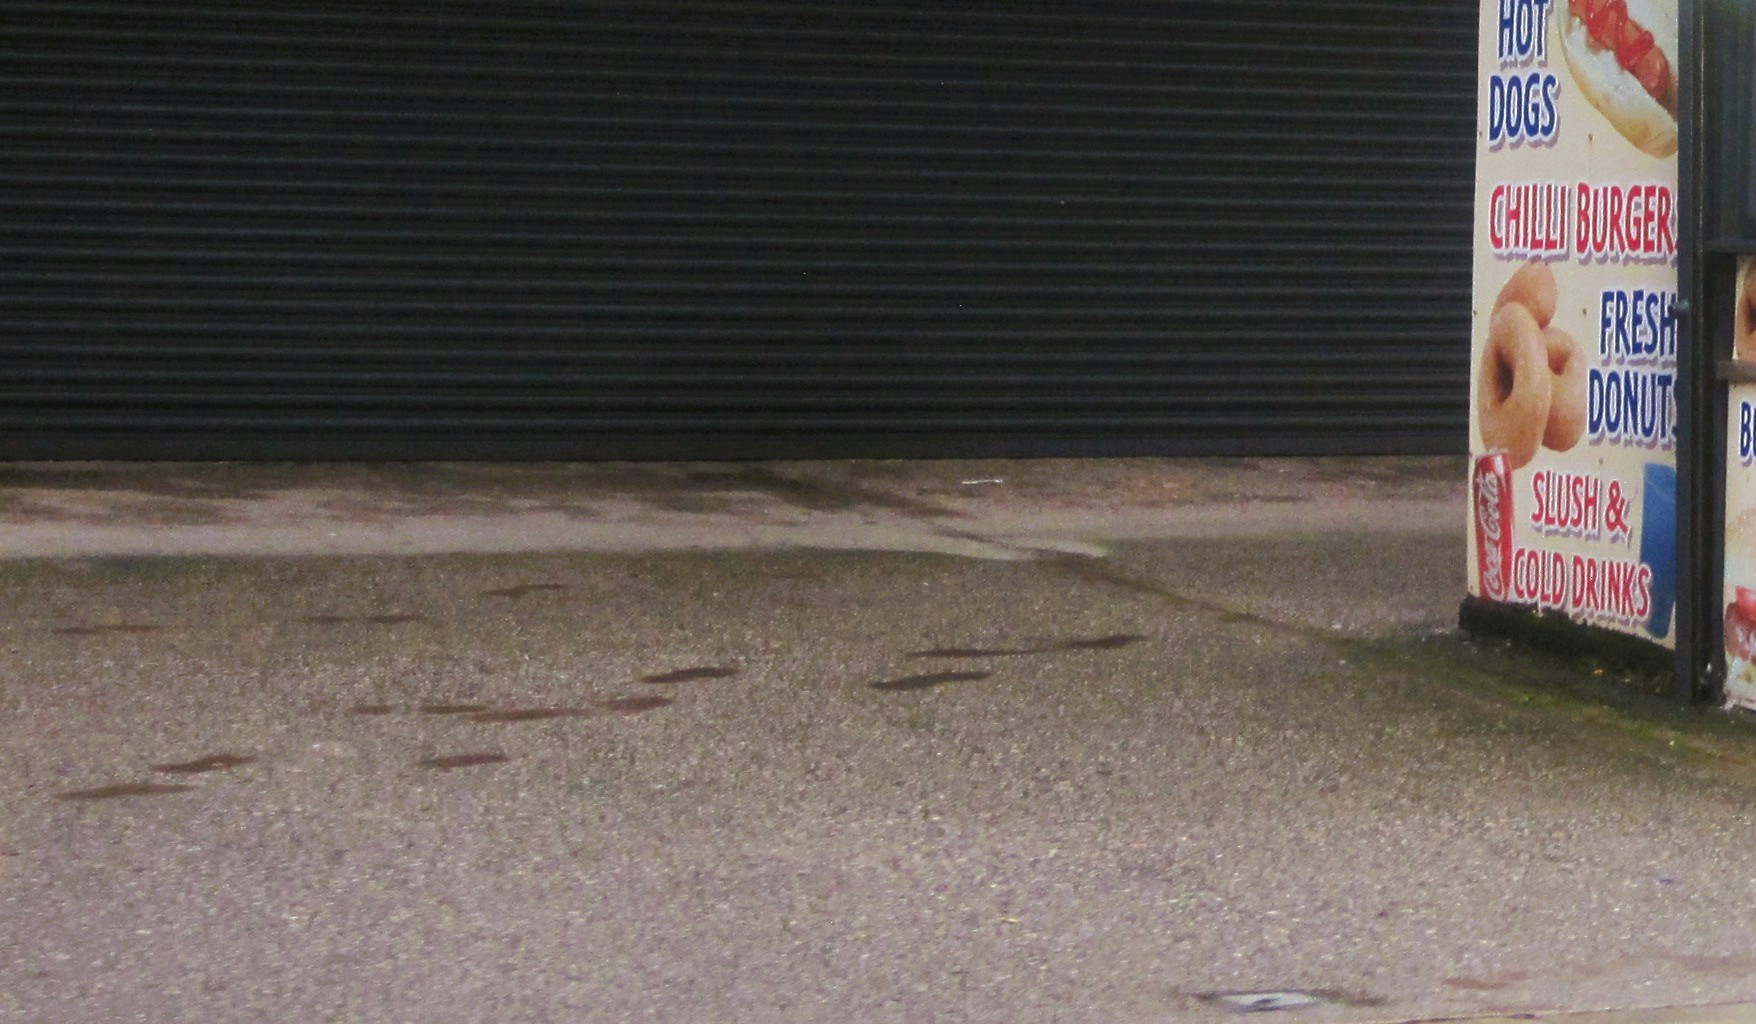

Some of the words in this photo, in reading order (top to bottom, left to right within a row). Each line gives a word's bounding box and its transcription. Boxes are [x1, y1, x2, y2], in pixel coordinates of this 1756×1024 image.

[1489, 74, 1557, 144] DOGS
[1490, 185, 1569, 255] CHILLI
[1575, 183, 1679, 253] BURGER
[1601, 290, 1677, 357] FRESH
[1531, 470, 1600, 530] SLUSH
[1605, 480, 1629, 534] &
[1513, 547, 1567, 606] COLD
[1572, 554, 1651, 618] DRINKS
